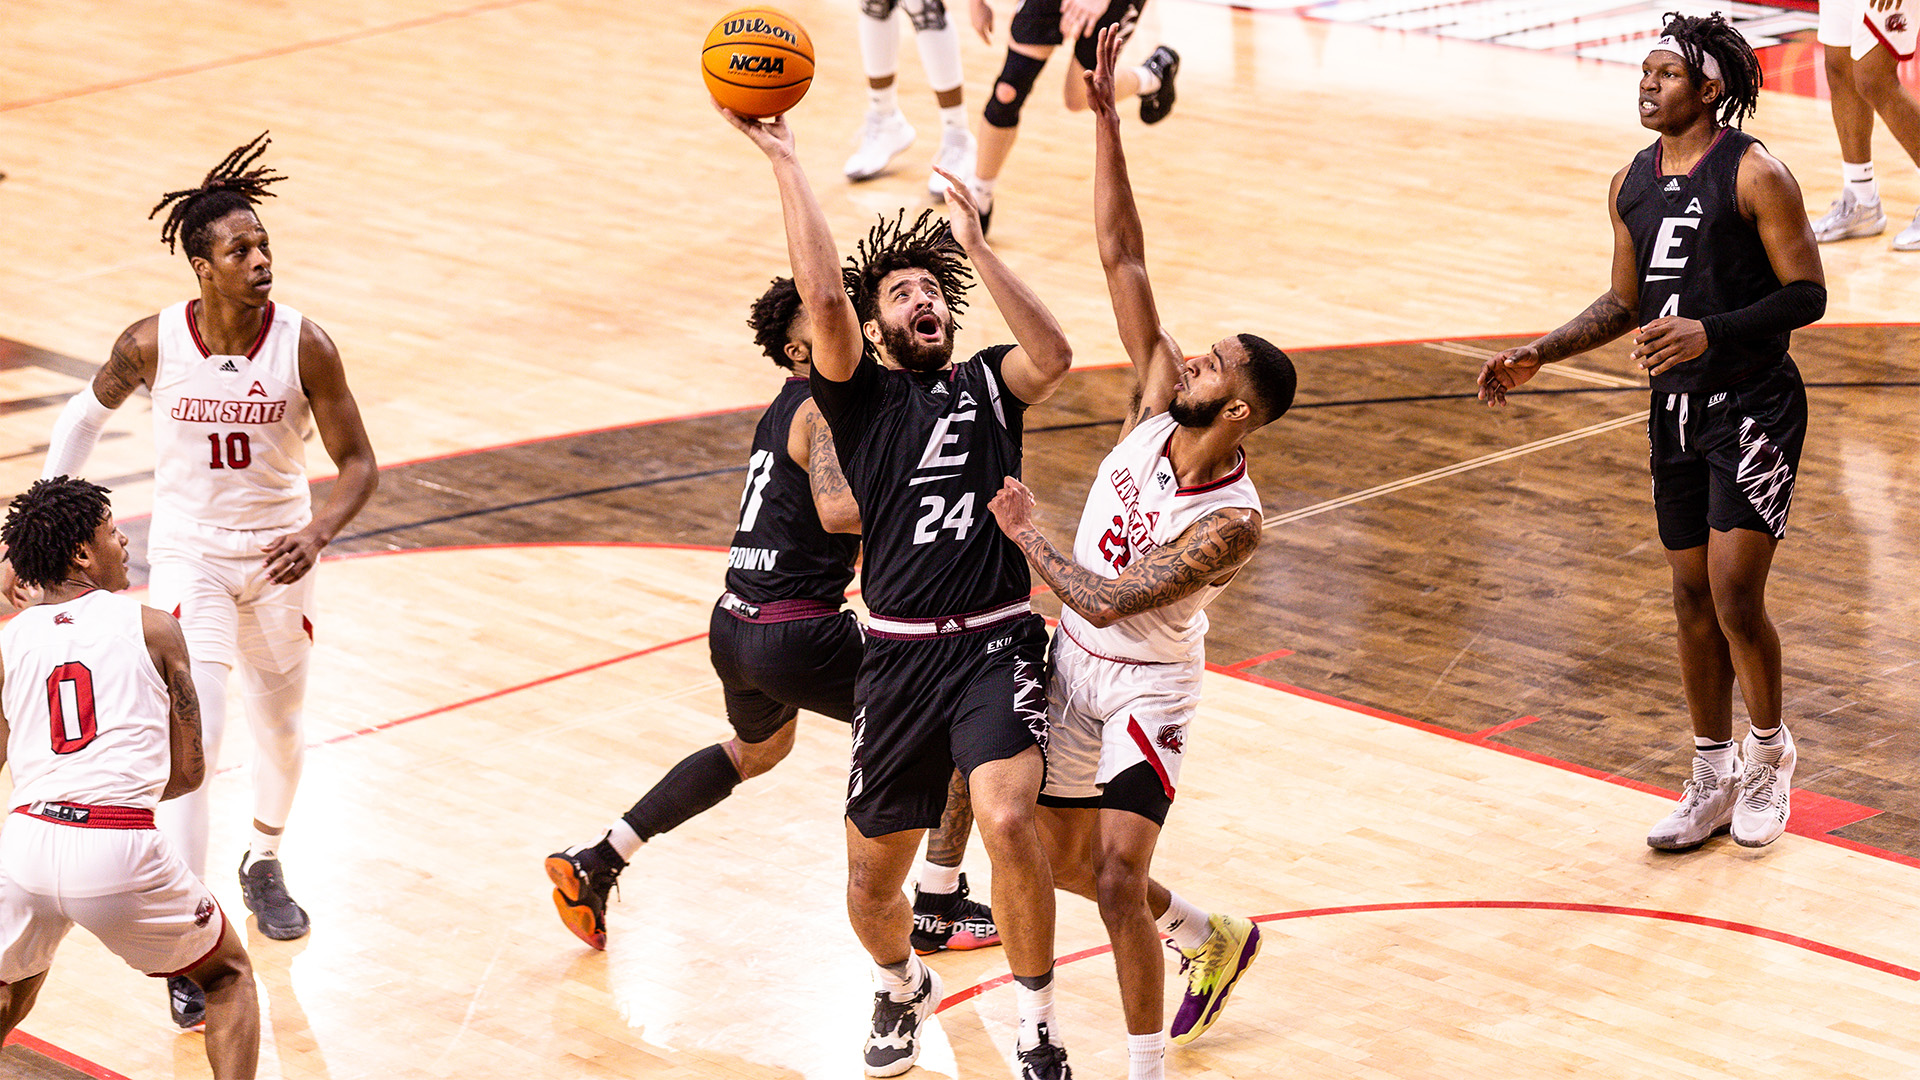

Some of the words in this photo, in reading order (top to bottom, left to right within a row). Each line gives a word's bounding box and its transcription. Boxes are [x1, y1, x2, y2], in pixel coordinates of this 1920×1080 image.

[723, 18, 798, 46] Wilson
[728, 53, 785, 74] NCAA
[1649, 217, 1701, 269] E
[171, 397, 220, 422] JAX
[220, 400, 287, 424] STATE
[1708, 391, 1728, 404] EKU
[208, 431, 252, 470] 10
[916, 409, 977, 470] E
[1110, 467, 1139, 513] JAX
[913, 492, 976, 545] 24
[987, 636, 1012, 652] EKU
[46, 661, 98, 755] 0
[951, 921, 997, 938] DEEP
